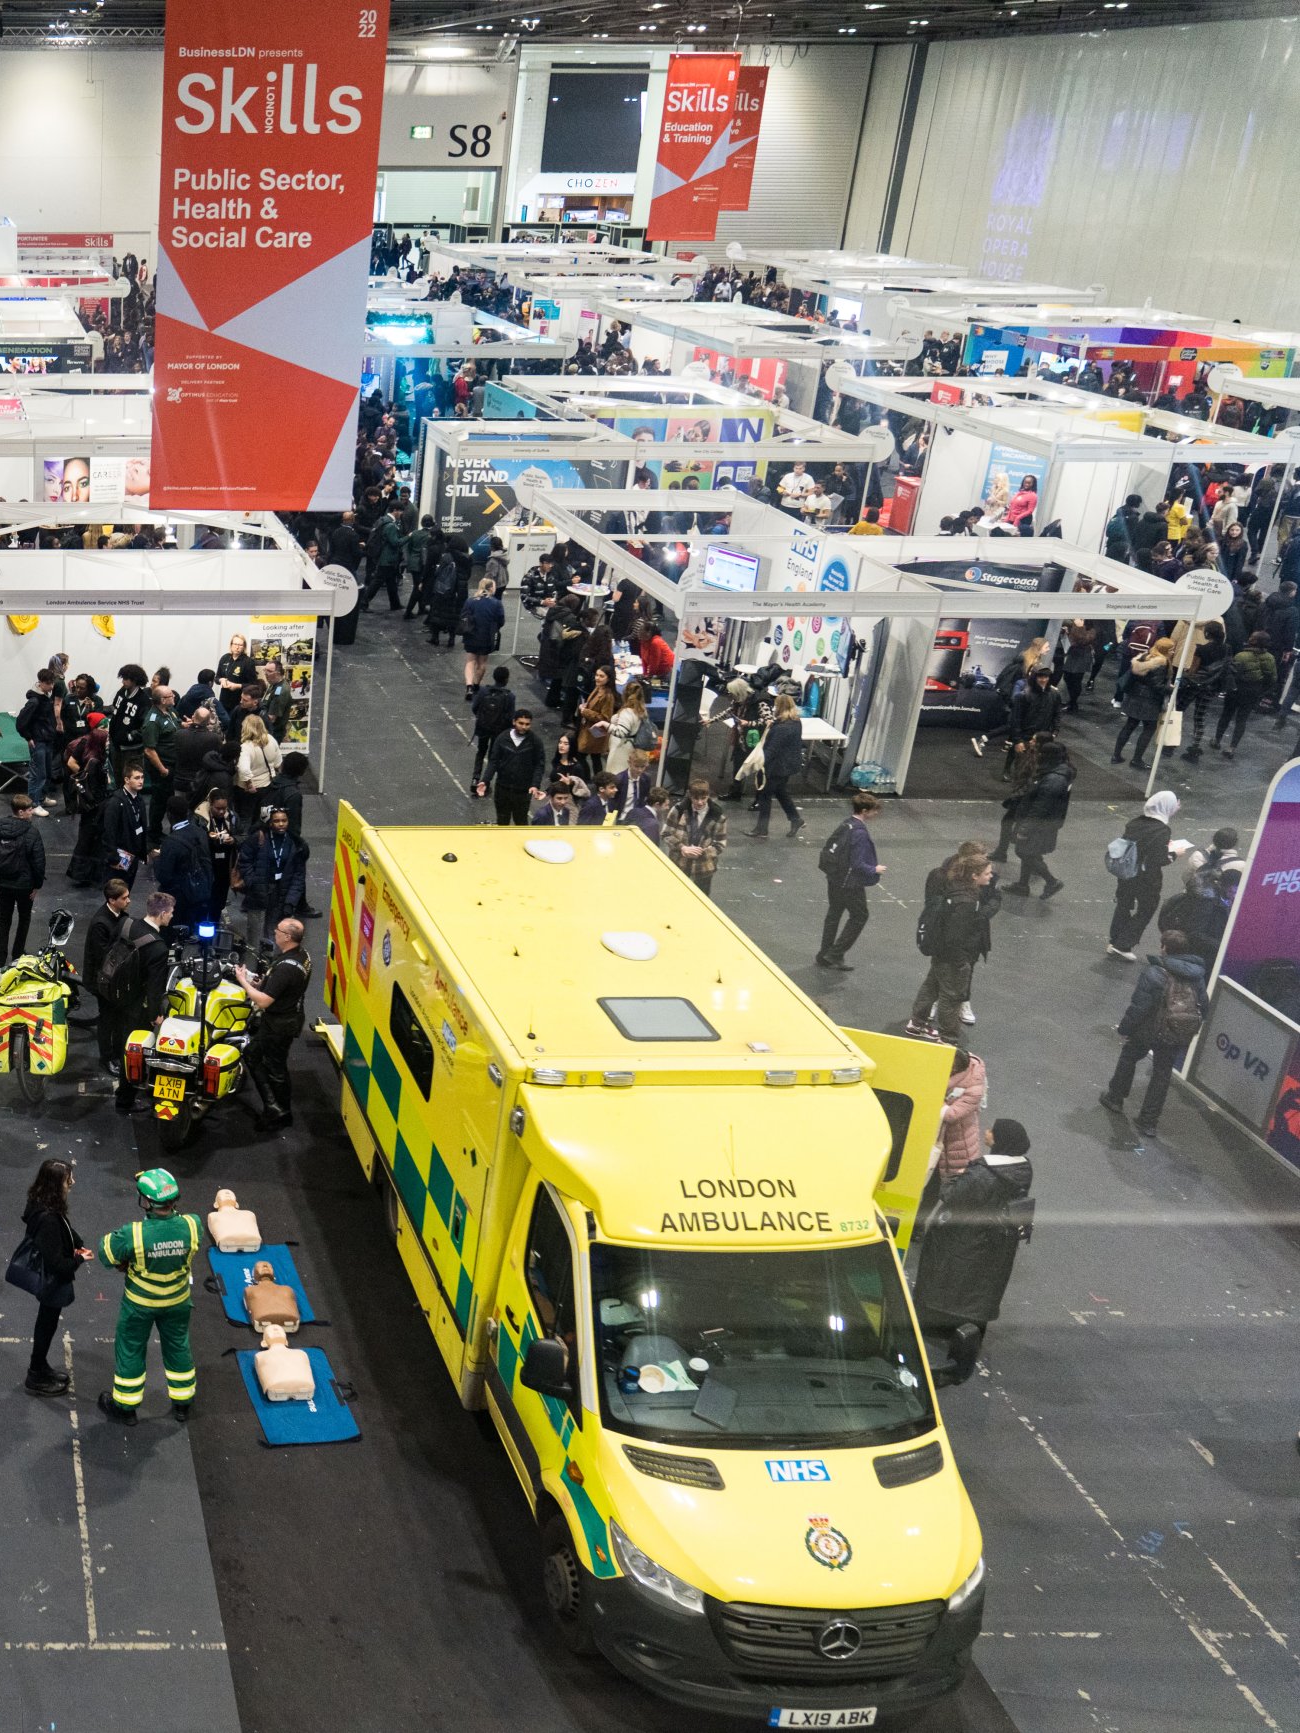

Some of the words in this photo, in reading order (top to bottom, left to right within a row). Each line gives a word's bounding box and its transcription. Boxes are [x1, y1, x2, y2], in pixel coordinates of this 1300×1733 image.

[359, 9, 377, 24] 20
[358, 23, 376, 38] 22
[179, 47, 255, 58] BusinessLDN
[258, 48, 303, 60] presents
[174, 63, 363, 135] Skills
[667, 87, 729, 113] Skills
[264, 86, 275, 134] LONDON
[664, 122, 713, 133] Education
[447, 124, 492, 158] S8
[663, 133, 671, 143] &
[674, 133, 712, 145] Training
[173, 168, 251, 191] Public
[259, 168, 345, 194] Sector,
[567, 178, 618, 188] CHOZEN
[172, 197, 251, 220] Health
[260, 197, 278, 220] &
[986, 213, 1033, 235] ROYAL
[85, 237, 109, 247] Skills
[171, 226, 246, 248] Social
[255, 226, 312, 248] Care
[983, 237, 1029, 257] OPERA
[446, 456, 491, 468] NEVER
[462, 470, 508, 483] STAND
[445, 485, 479, 497] STILL
[787, 558, 813, 581] England
[981, 572, 1039, 586] Stagecoach
[382, 882, 411, 942] Emergency
[434, 969, 468, 1037] Ambulance
[1243, 1051, 1270, 1082] VR
[158, 1077, 183, 1089] LX18
[158, 1087, 180, 1099] ATN
[680, 1179, 797, 1199] LONDON
[660, 1211, 833, 1233] AMBULANCE
[840, 1219, 870, 1232] 8732
[153, 1240, 184, 1251] LONDON
[769, 1460, 827, 1481] NHS
[788, 1711, 832, 1726] LX19
[836, 1710, 872, 1725] ABK
